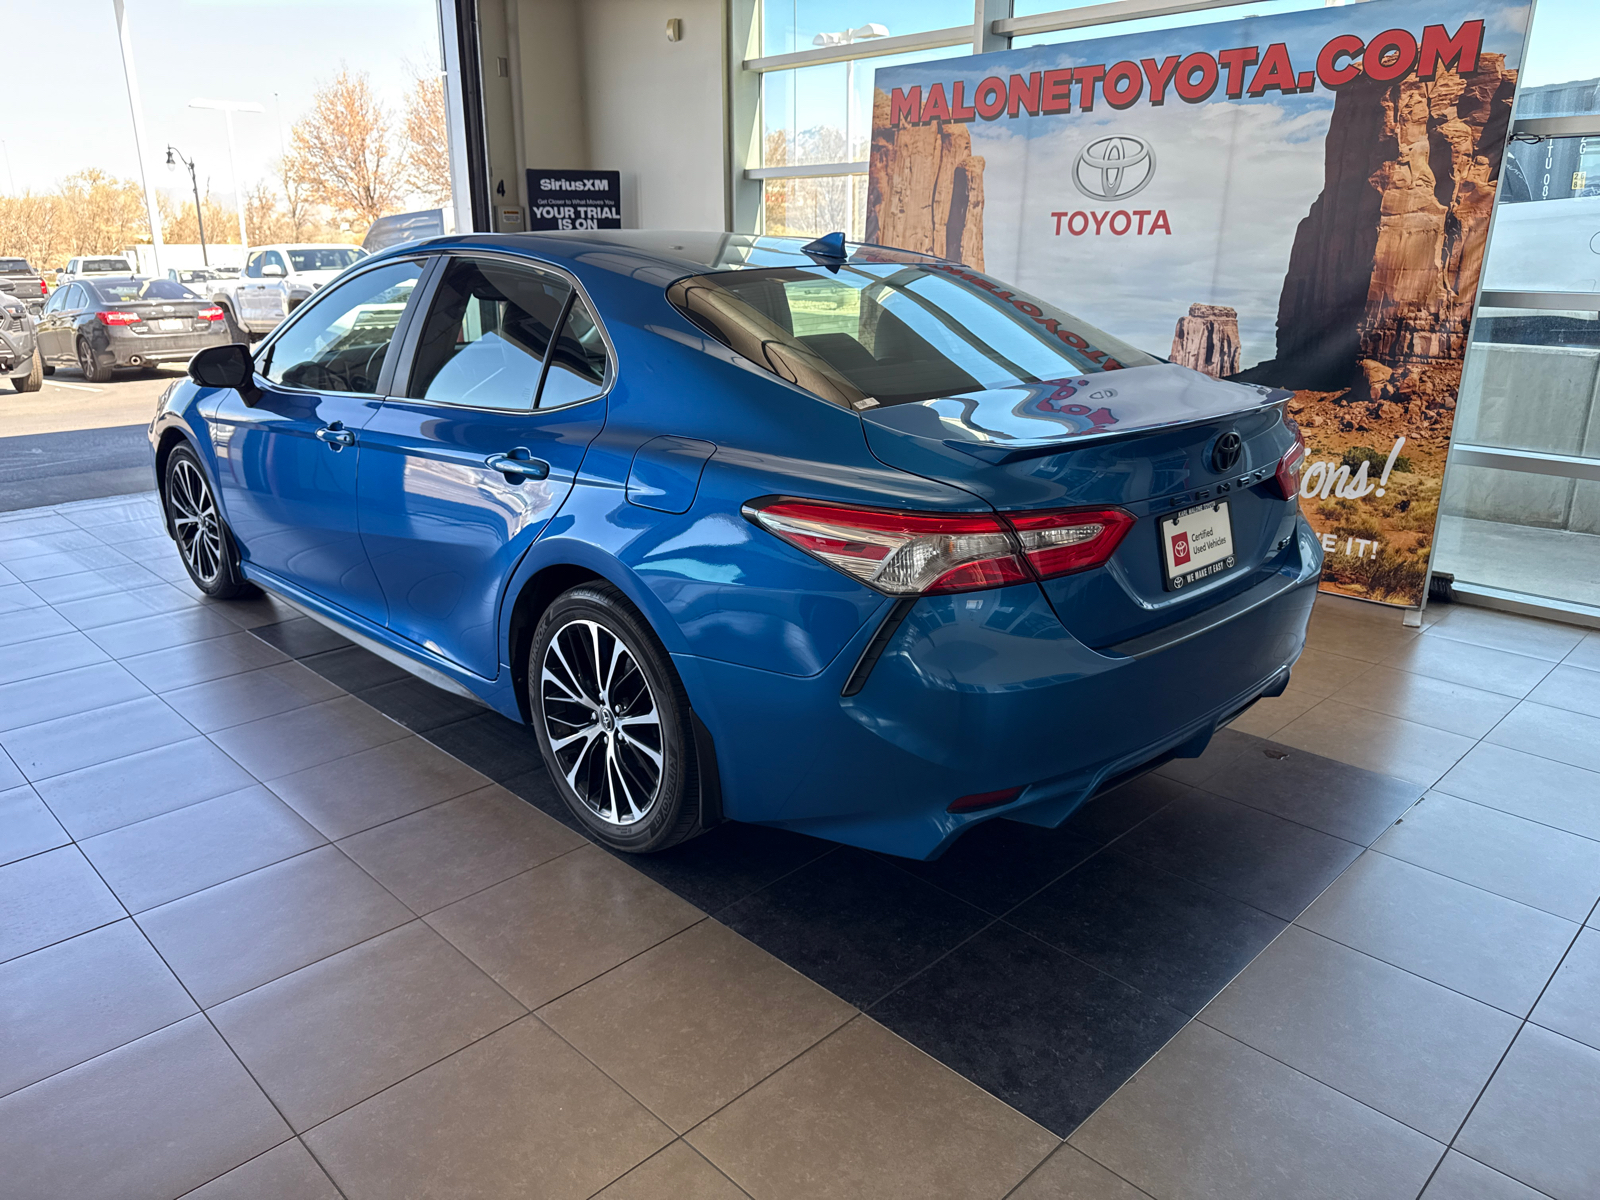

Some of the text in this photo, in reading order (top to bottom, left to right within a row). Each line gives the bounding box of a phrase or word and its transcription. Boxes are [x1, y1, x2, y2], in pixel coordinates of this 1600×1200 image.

[890, 19, 1485, 127] MALONETOYOTA.COM
[496, 179, 506, 197] 4
[540, 178, 609, 191] SiriusXM
[533, 206, 575, 219] YOUR
[577, 207, 620, 219] TRIAL
[558, 219, 598, 230] IS ON
[1051, 209, 1172, 236] TOYOTA
[1299, 436, 1406, 500] ons!
[1170, 469, 1266, 506] CAMRY
[1191, 527, 1213, 542] Certified
[1193, 537, 1227, 555] Used Vehicles
[1345, 536, 1379, 560] IT!
[1186, 564, 1224, 583] WE MAKE IT EASY
[660, 756, 677, 819] KINERGY
